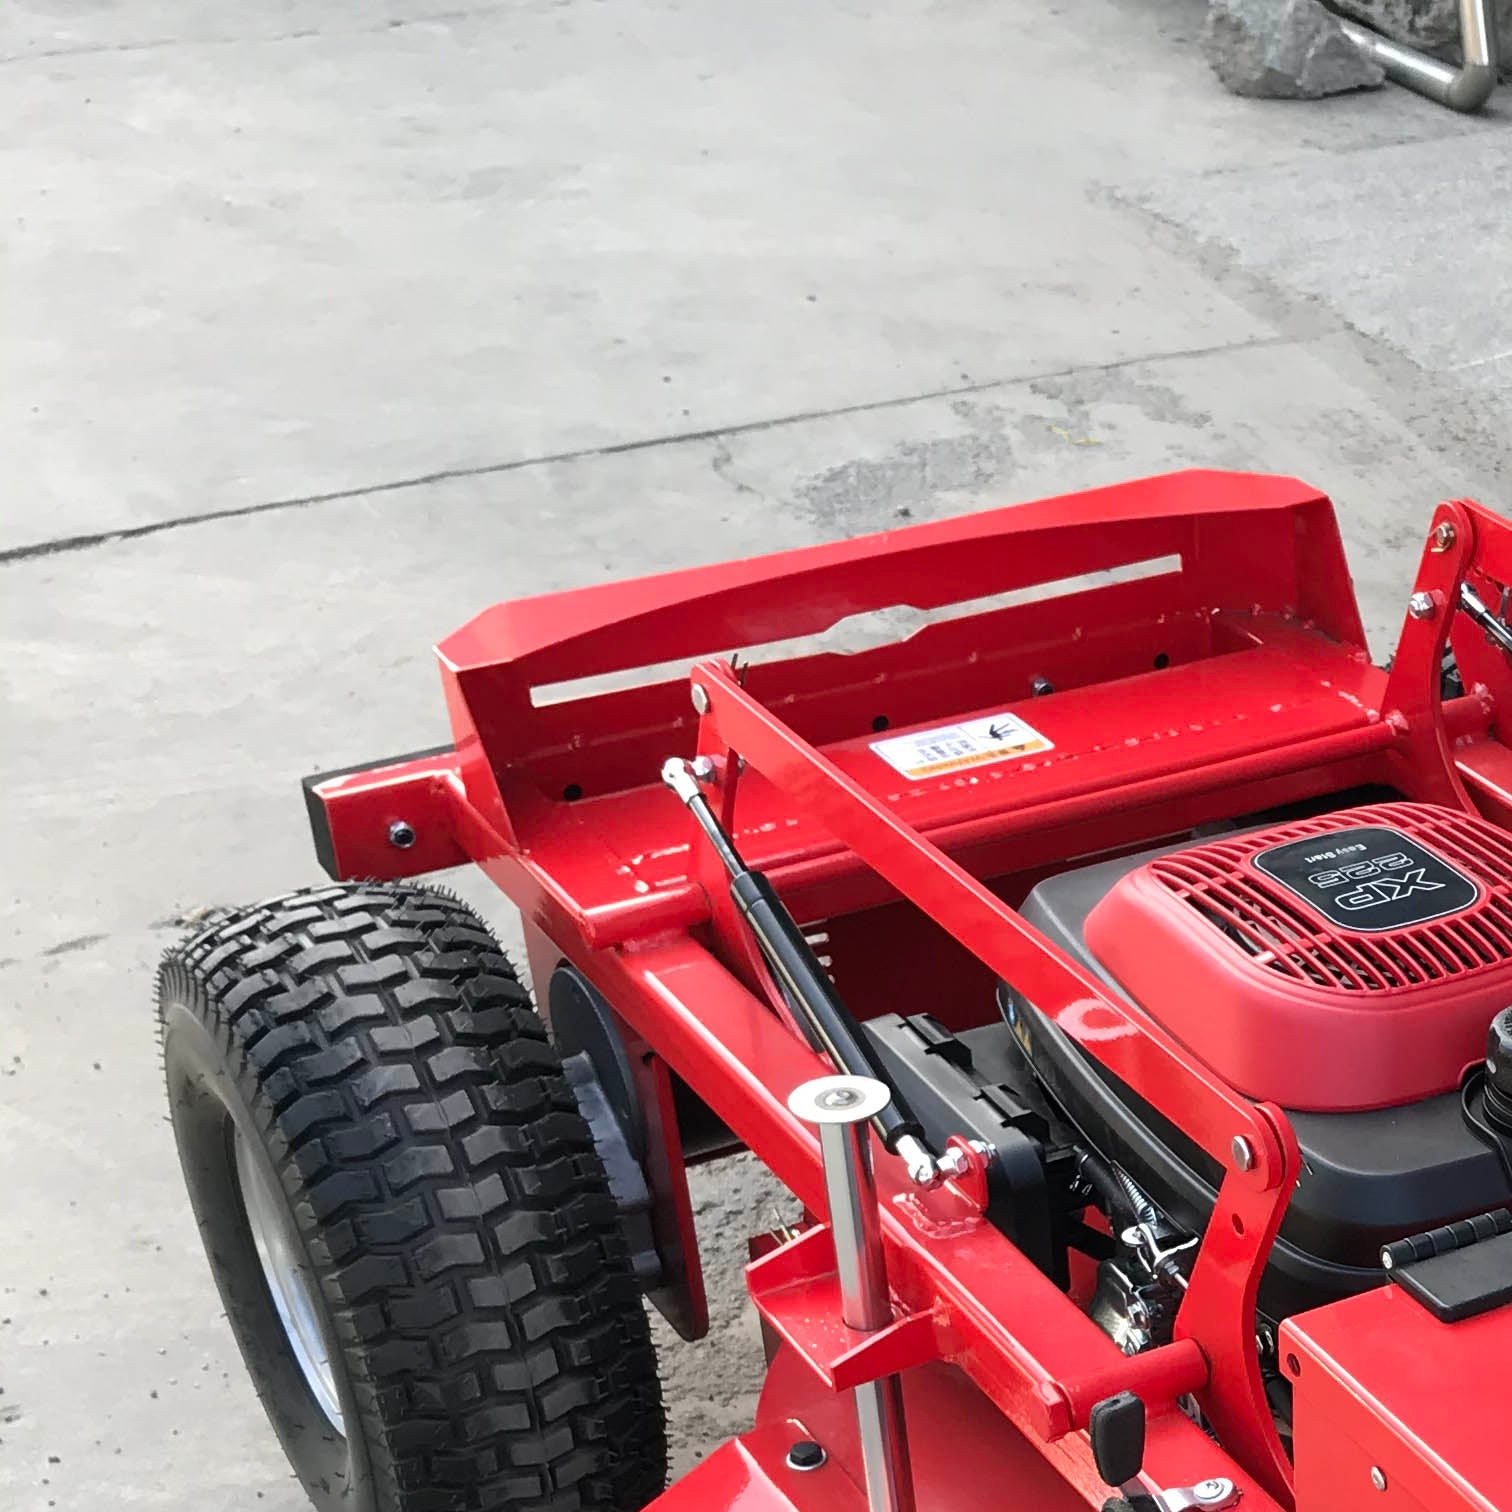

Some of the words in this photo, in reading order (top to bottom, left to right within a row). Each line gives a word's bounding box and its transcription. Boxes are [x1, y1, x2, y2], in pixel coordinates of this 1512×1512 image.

[1304, 851, 1336, 863] Start
[1336, 843, 1367, 857] Easy
[1308, 852, 1414, 888] 225
[1335, 868, 1446, 910] XP
